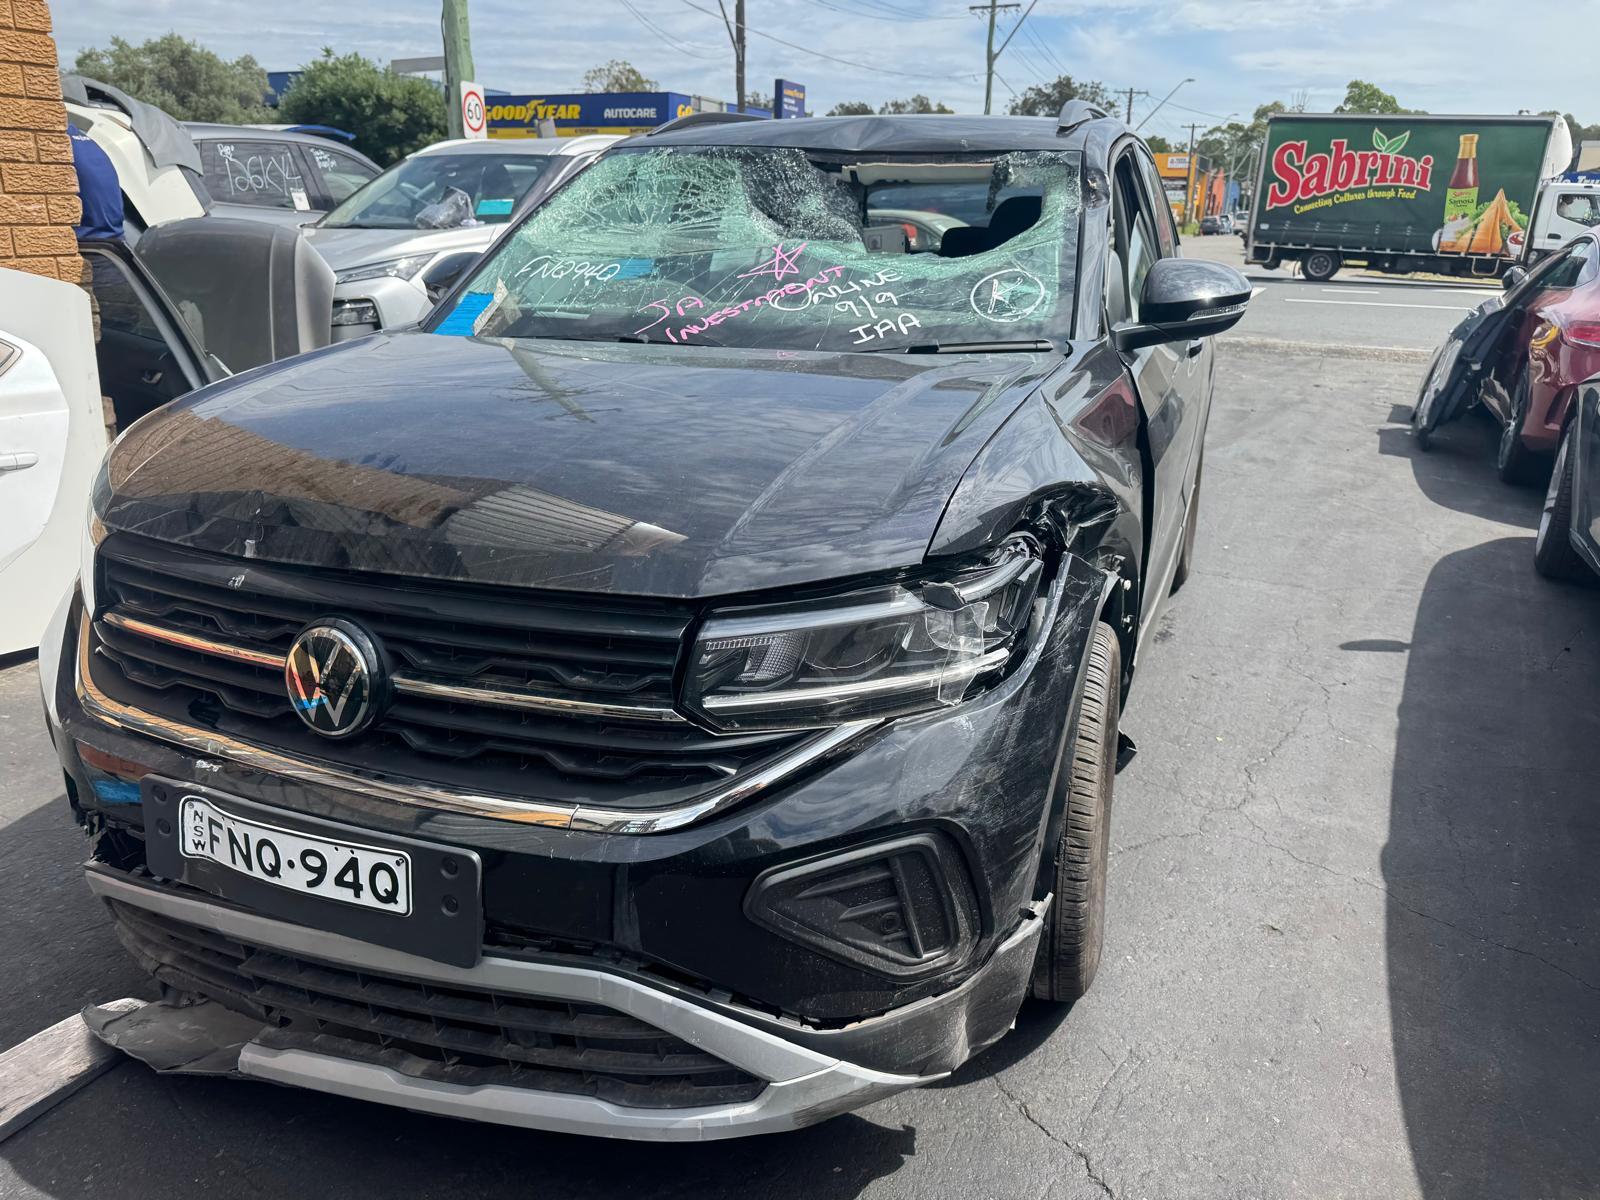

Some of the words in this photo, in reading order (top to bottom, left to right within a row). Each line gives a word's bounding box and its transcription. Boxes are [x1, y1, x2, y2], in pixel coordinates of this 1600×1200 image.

[467, 102, 481, 121] 60
[603, 107, 657, 119] AUTOCARE
[1266, 138, 1434, 211] Sabrini
[1294, 197, 1333, 214] Connecting
[1334, 193, 1366, 204] Cultures
[1367, 188, 1396, 200] through
[1398, 188, 1417, 199] Food
[514, 255, 621, 282] FNQ94Q
[769, 268, 903, 311] ONLINE
[849, 312, 922, 344] IAA
[192, 810, 206, 851] NSW
